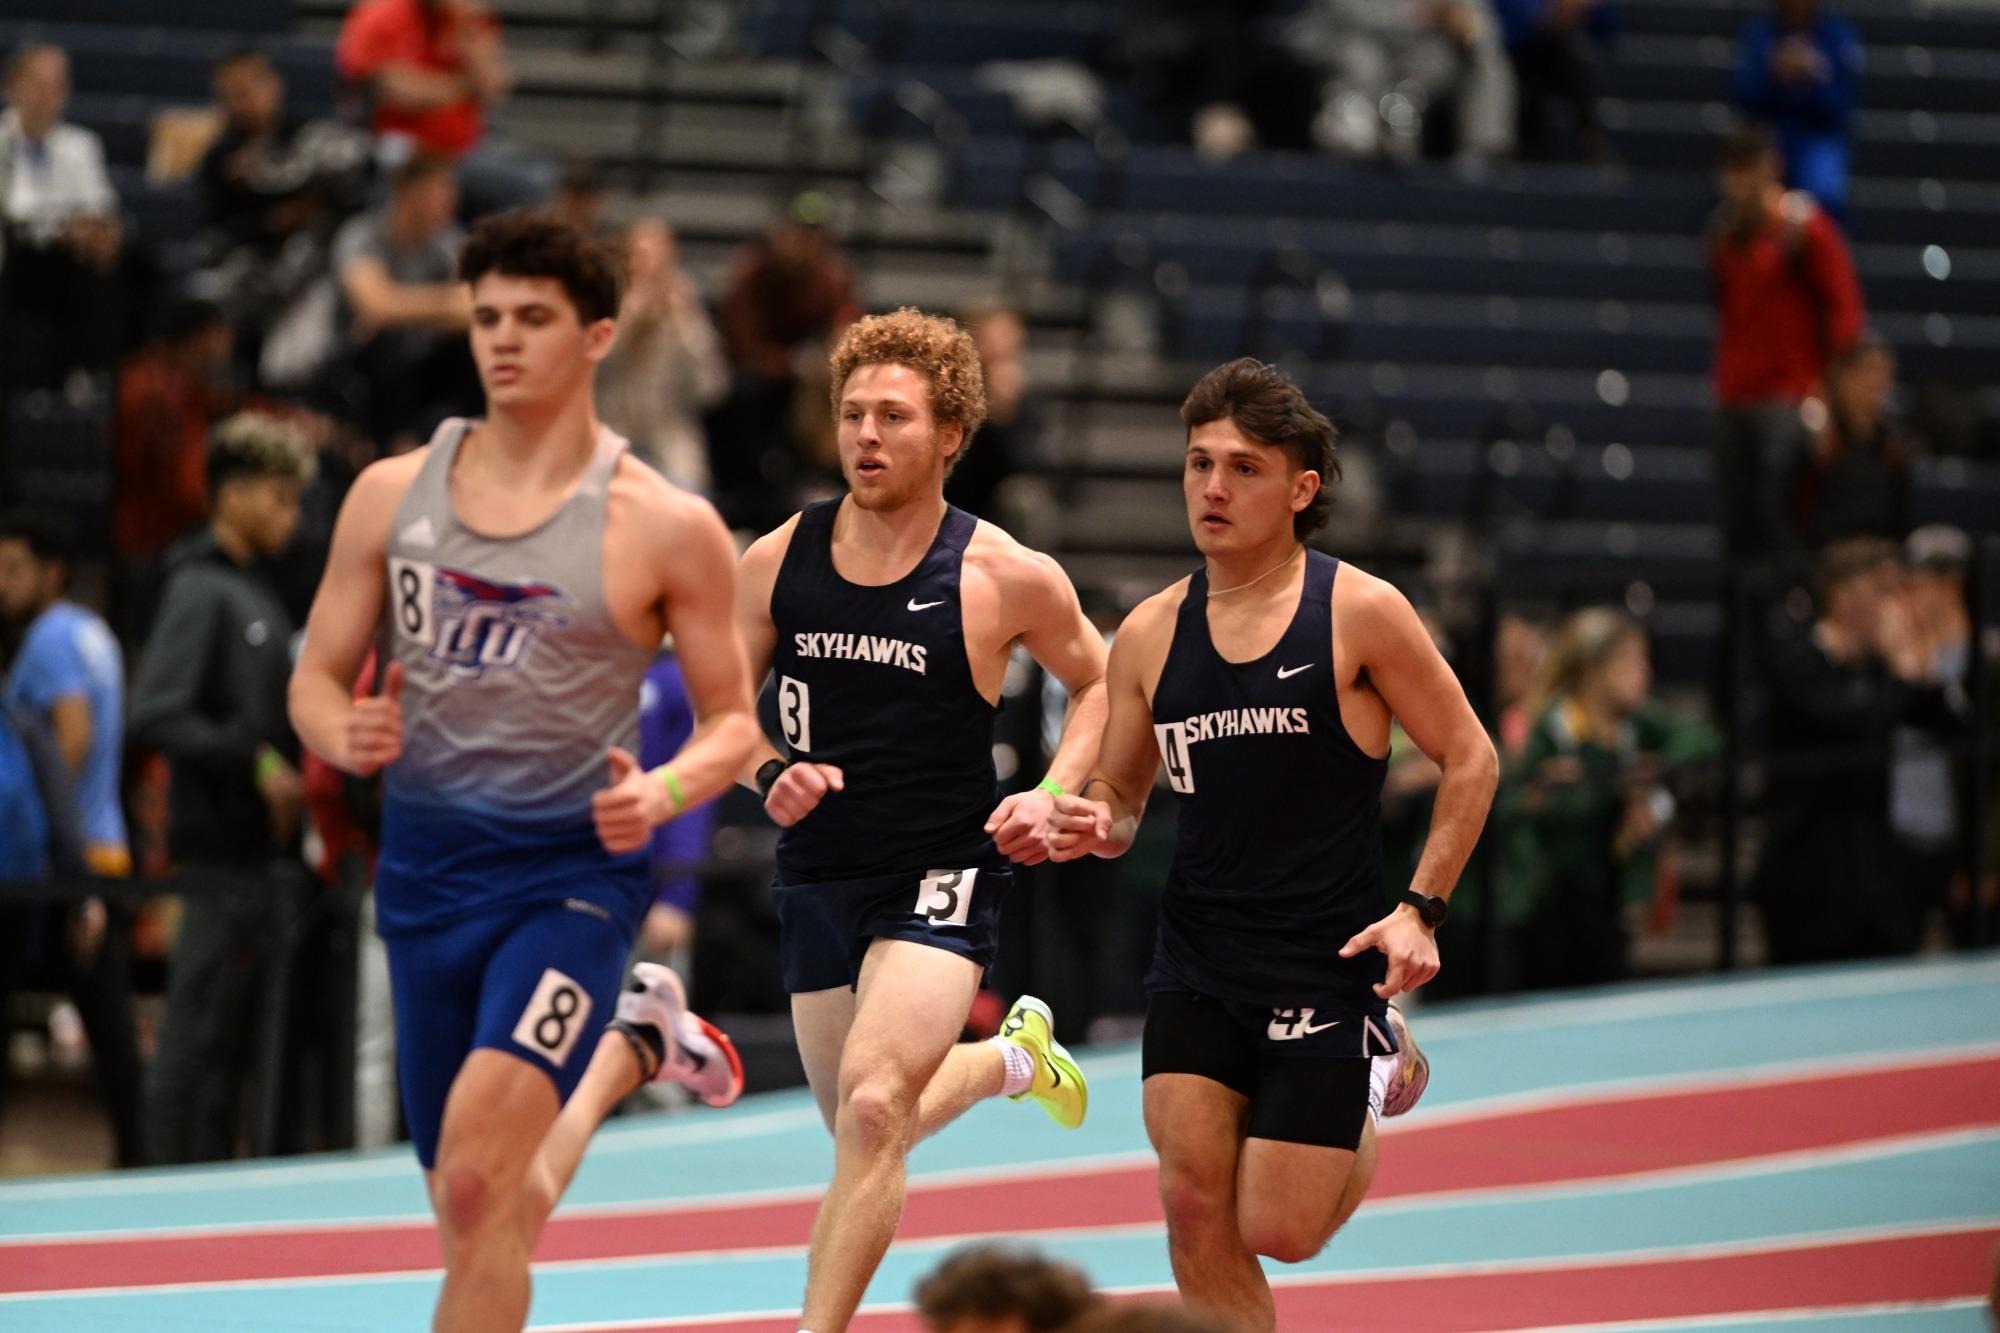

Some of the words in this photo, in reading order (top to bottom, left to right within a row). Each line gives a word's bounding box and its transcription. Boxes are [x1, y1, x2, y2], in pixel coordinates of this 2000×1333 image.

[399, 567, 423, 634] 8
[794, 632, 928, 675] SKYHAWKS
[786, 682, 801, 745] 3
[1185, 707, 1310, 745] SKYHAWKS
[1165, 728, 1186, 790] 4
[926, 870, 964, 920] 3
[535, 987, 579, 1049] 8
